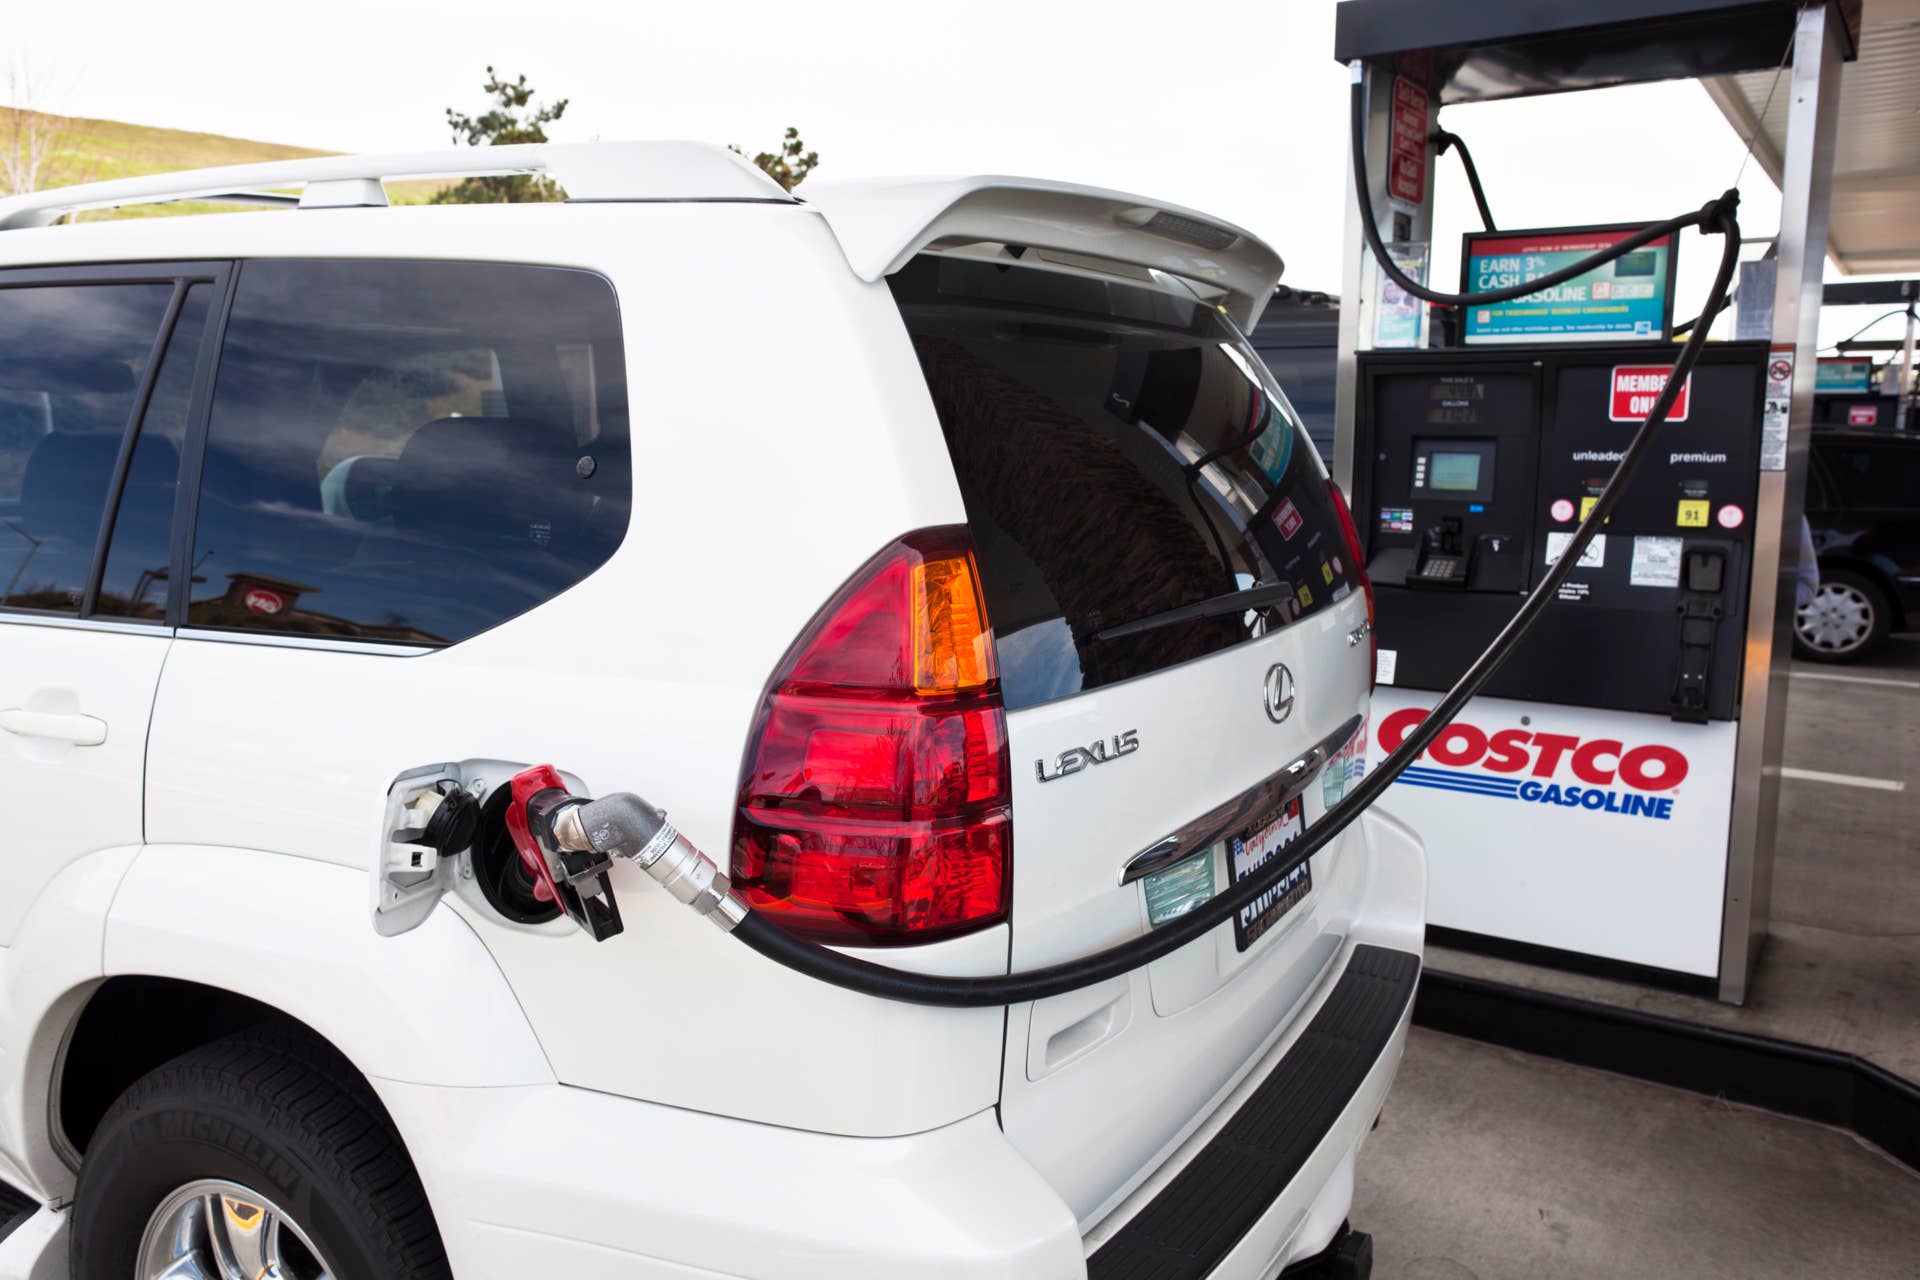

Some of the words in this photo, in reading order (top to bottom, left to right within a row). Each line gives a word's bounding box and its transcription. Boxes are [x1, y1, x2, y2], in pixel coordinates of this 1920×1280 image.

[1480, 258, 1520, 273] EARN
[1525, 257, 1545, 272] 3%
[1478, 273, 1520, 289] CASH
[1616, 374, 1685, 393] MEMBE
[1670, 452, 1727, 464] premium
[1684, 511, 1700, 521] 91
[1034, 729, 1140, 784] LEXUS
[1377, 707, 1689, 792] COSTCO
[1519, 781, 1675, 820] GASOLINE
[158, 1108, 302, 1192] MICHELIN
